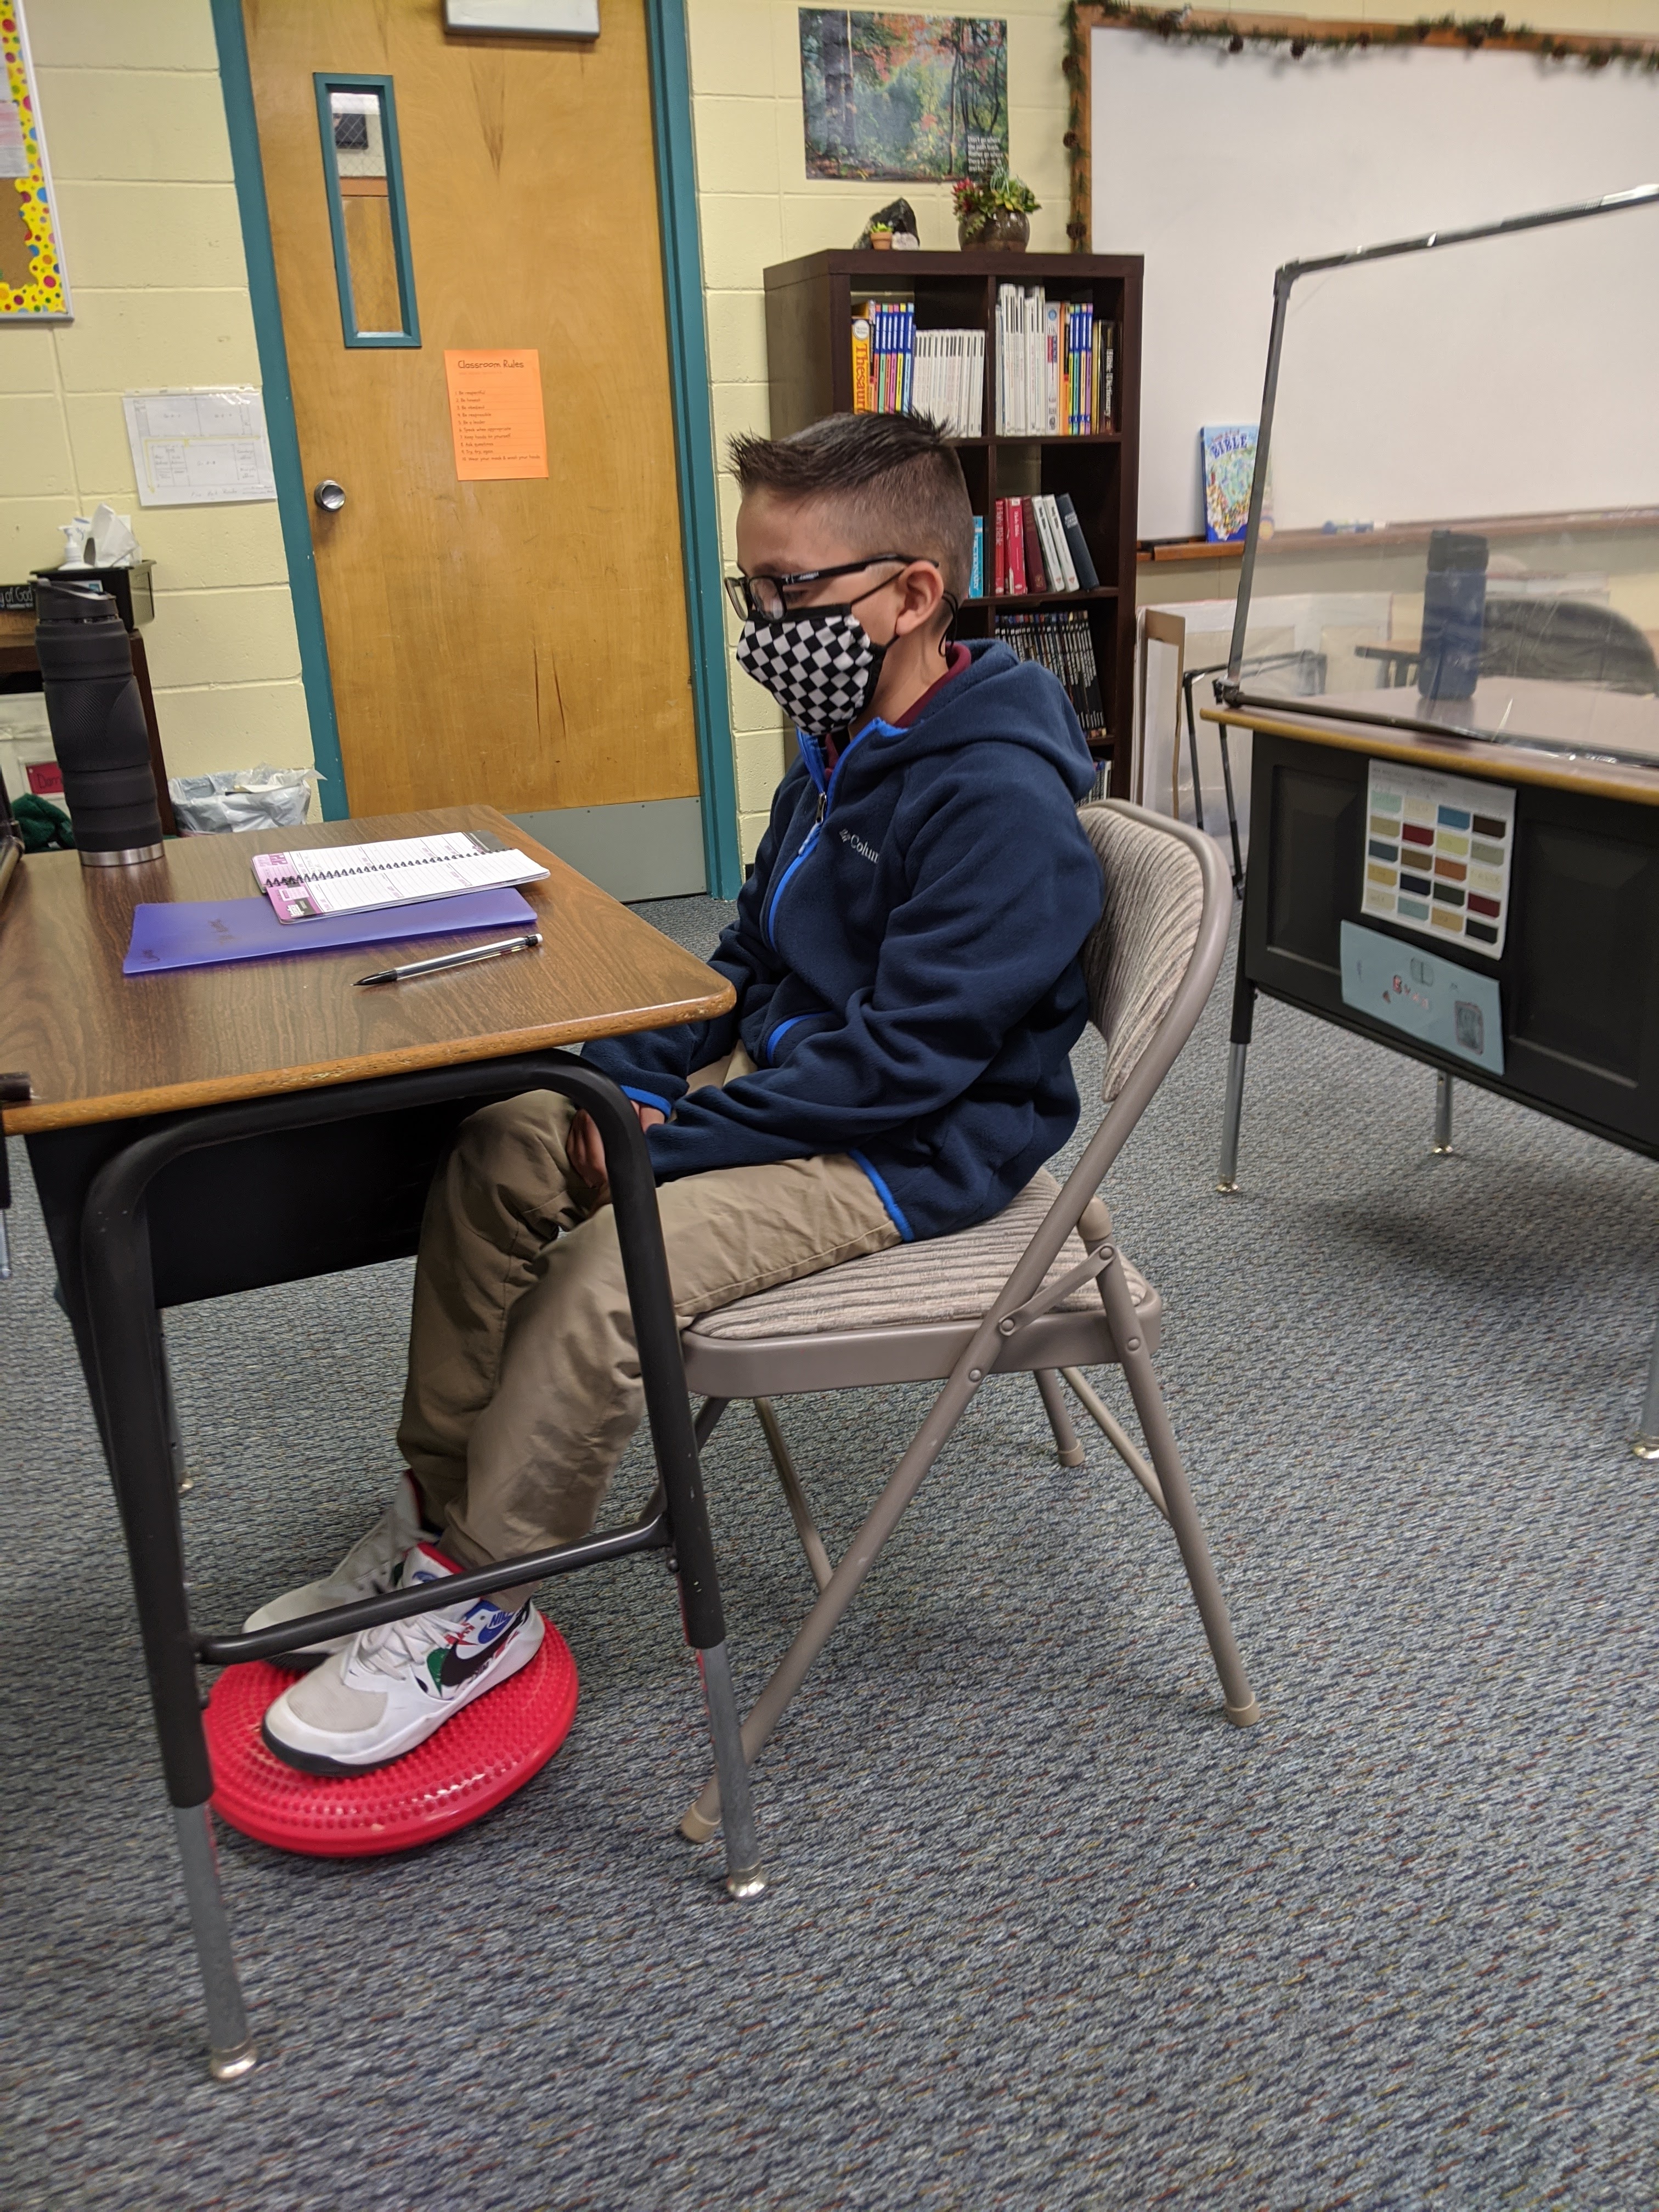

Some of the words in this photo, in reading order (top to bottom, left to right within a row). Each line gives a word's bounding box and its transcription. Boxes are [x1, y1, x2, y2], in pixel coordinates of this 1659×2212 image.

[458, 360, 501, 369] Classroom
[503, 359, 524, 368] Rules
[15, 586, 33, 602] God
